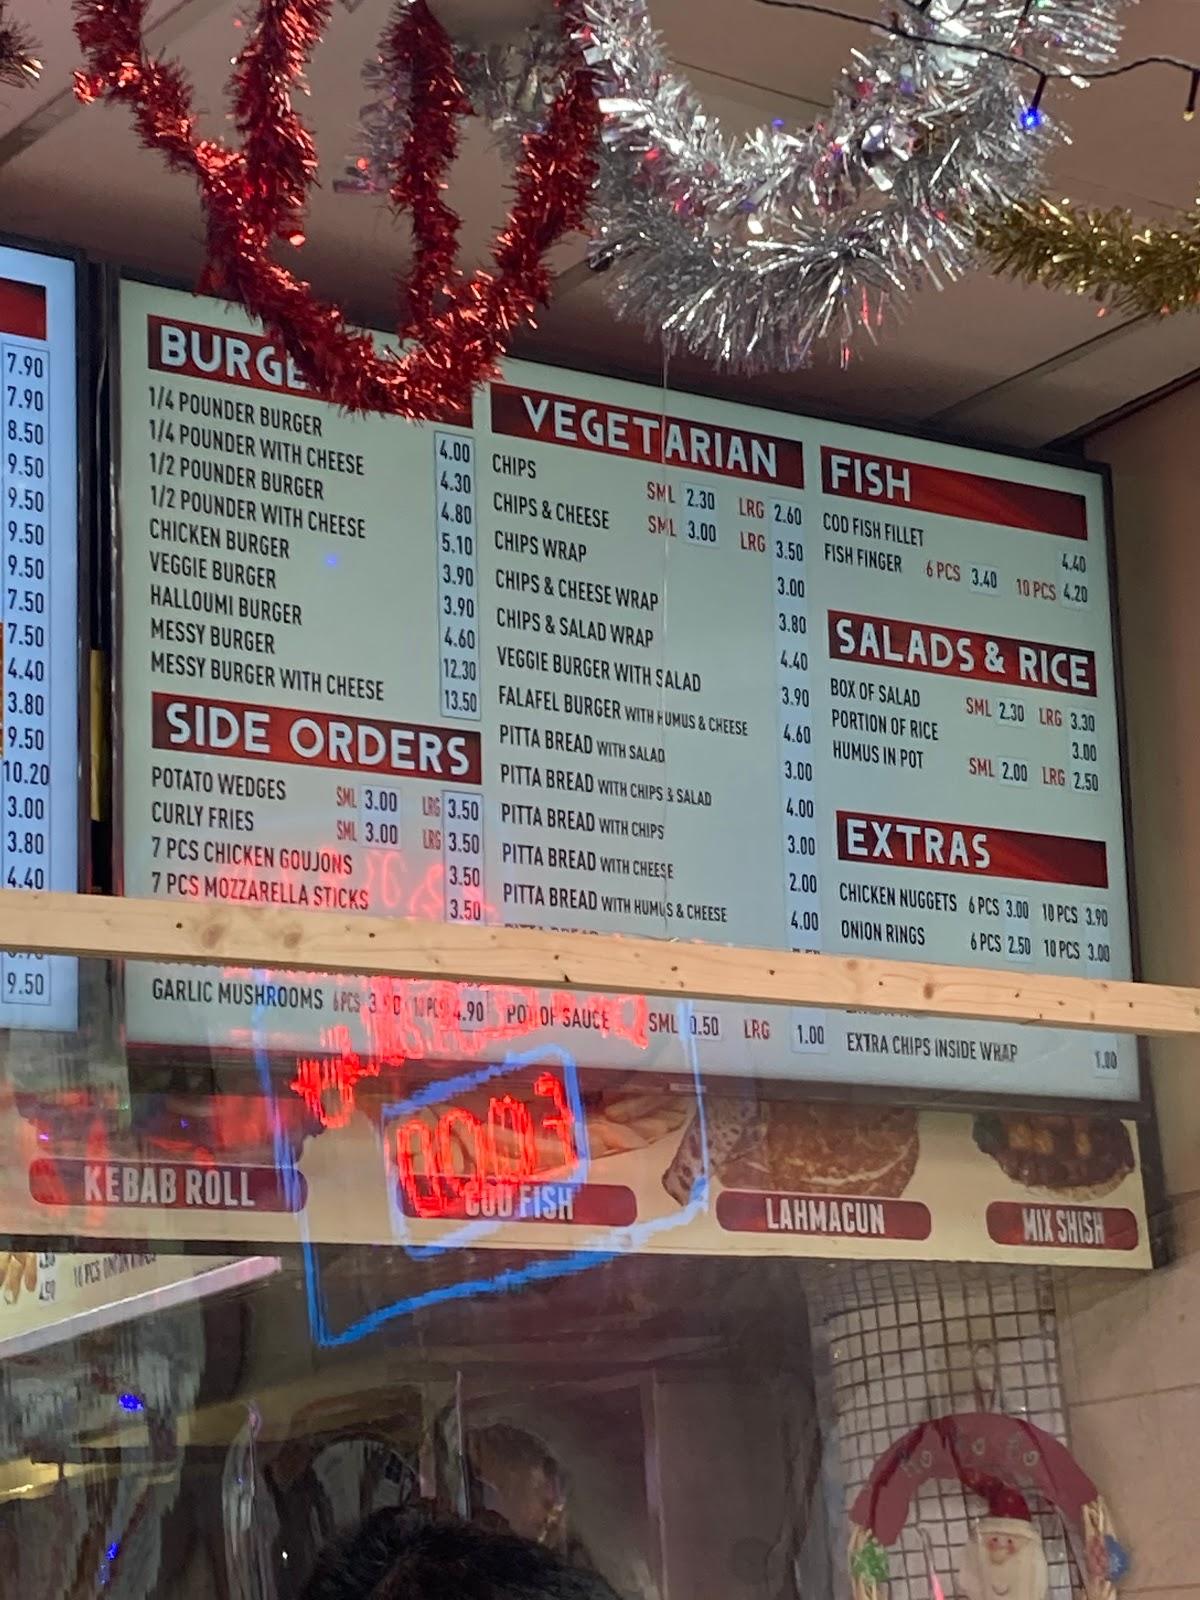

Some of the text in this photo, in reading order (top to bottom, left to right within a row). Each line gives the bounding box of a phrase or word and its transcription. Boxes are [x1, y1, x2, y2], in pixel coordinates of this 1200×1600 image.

[8, 352, 43, 378] 7.90
[160, 326, 307, 389] BURGE
[8, 385, 43, 411] 7.90
[8, 419, 43, 445] 8.50
[150, 387, 470, 463] 1/4 POUNDER BURGER 4.00
[522, 395, 777, 477] VEGETARIAN
[8, 453, 43, 479] 9.50
[150, 420, 471, 494] 1/4 POUNDER WITH CHEESE 4.30
[830, 454, 911, 502] FISH
[150, 453, 471, 525] 1/2 POUNDER BURGER 4.80
[492, 454, 802, 526] CHIPS SML 2.30 LRG 2.60
[150, 486, 472, 556] 1/2 POUNDER WITH CHEESE 5.10
[823, 512, 1086, 573] COD FISH FILLET 4.40
[150, 519, 473, 587] CHICKEN BURGER 3.90
[495, 530, 805, 598] CHIPS WRAP 3.00
[825, 543, 1087, 603] FISH FINGER 6 PCS 3.40 10 PCS 4.20
[8, 588, 43, 613] 7.50
[150, 551, 474, 618] VEGGIE BURGER 3.90
[8, 623, 43, 647] 7.50
[150, 585, 475, 650] HALLOUMI BURGER 4.60
[8, 657, 43, 680] 4.40
[151, 618, 476, 681] MESSY BURGER 12.30
[836, 619, 1089, 689] SALADS & RICE
[151, 651, 477, 712] MESSY BURGER WITH CHEESE 13.50
[498, 646, 809, 707] VEGGIE BURGER WITH SALAD 3.90
[8, 691, 43, 716] 3.80
[831, 678, 1095, 732] BOX OF SALAD SML 2.30 LRG 3.30
[8, 728, 43, 750] 9.50
[166, 703, 469, 775] SIDE ORDERS
[500, 724, 812, 781] PITTA BREAD WITH SALAD 3.00
[832, 709, 1096, 761] PORTION OF RICE 3.00
[3, 761, 49, 785] 10.20
[833, 740, 1098, 791] HUMUS IN POT SML 2.00 LRG 2.50
[8, 797, 43, 820] 3.00
[152, 766, 479, 821] POTATO WEDGES SML 3.00 LRG 3.50
[8, 831, 43, 854] 3.80
[501, 803, 815, 855] PITTA BREAD WITH CHIPS 3.00
[847, 818, 991, 869] EXTRAS
[8, 866, 43, 890] 4.40
[152, 837, 480, 887] 7 PCS CHICKEN GOUJONS 3.50
[152, 872, 481, 921] 7 PCS MOZZARELLA STICKS 3.50
[840, 883, 1108, 927] CHICKEN NUGGETS 6 PCS 3.00 10 PCS 3.90
[8, 973, 43, 995] 9.50
[153, 978, 323, 1010] GARLIC MUSHROOMS
[847, 1032, 888, 1053] EXTRA
[893, 1036, 930, 1056] CHIPS
[935, 1039, 977, 1060] INSIDE
[84, 1166, 255, 1206] KEBAB ROLL
[520, 1185, 574, 1220] FISH
[766, 1197, 885, 1235] LAHMACUN
[1022, 1208, 1105, 1245] MIX SHISH
